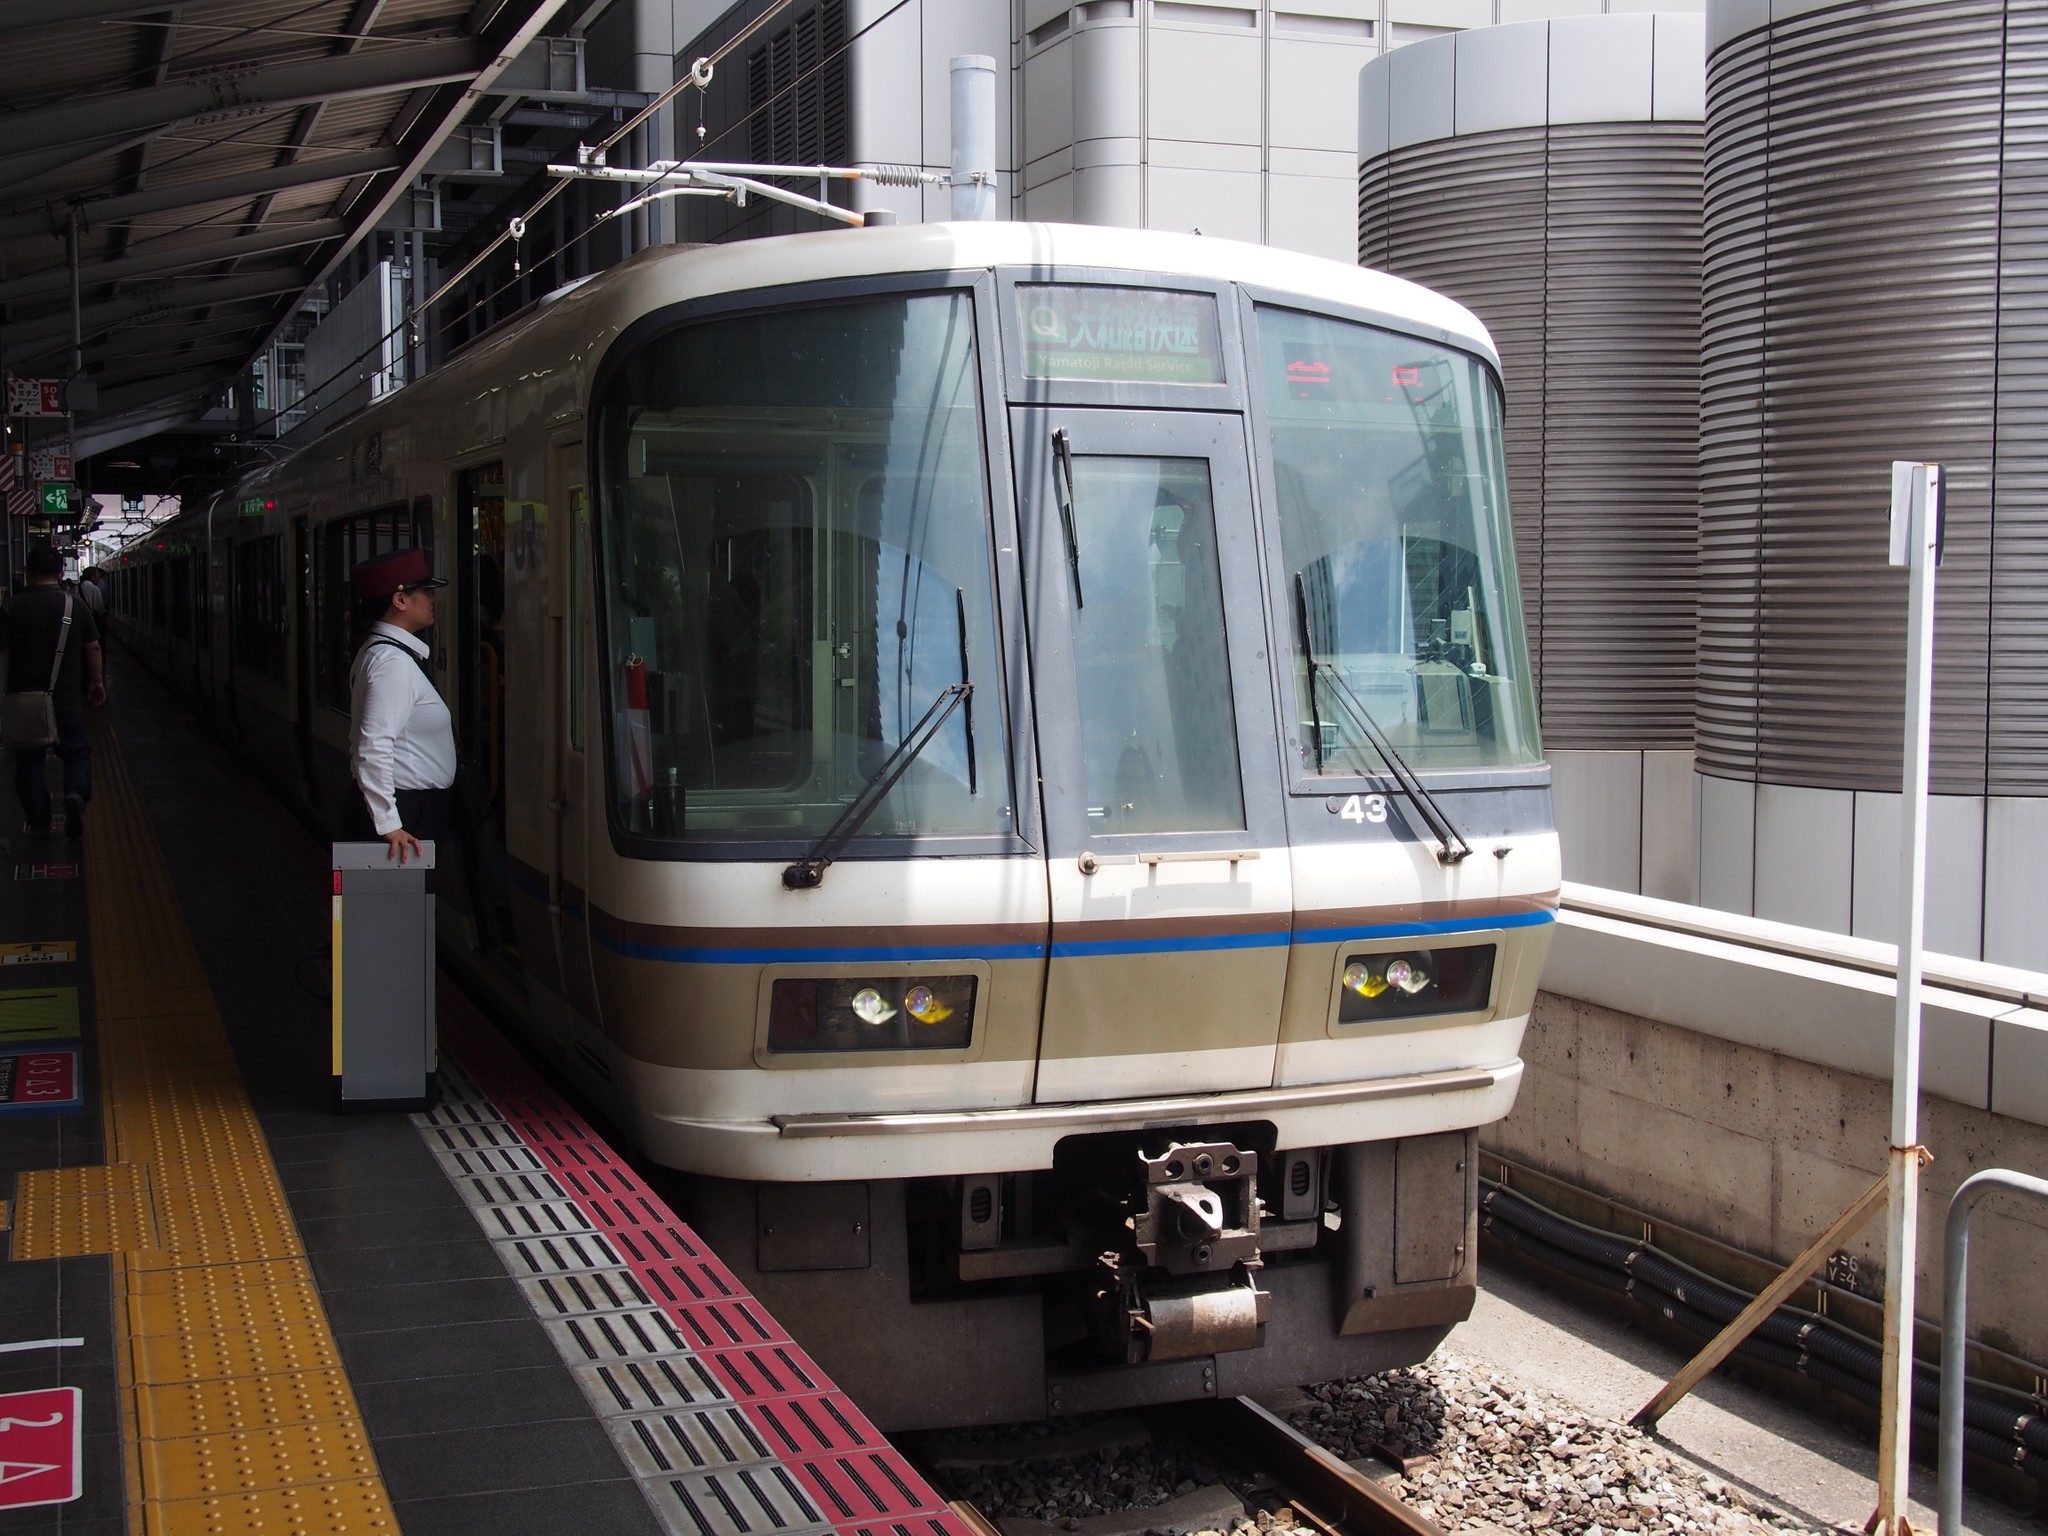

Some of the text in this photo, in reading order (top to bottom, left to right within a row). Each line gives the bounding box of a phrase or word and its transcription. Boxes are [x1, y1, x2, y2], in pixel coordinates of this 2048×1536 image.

[1070, 303, 1200, 353] 大和路快速
[1038, 353, 1193, 373] Yamatoji Rapid Service
[1340, 794, 1388, 824] 43
